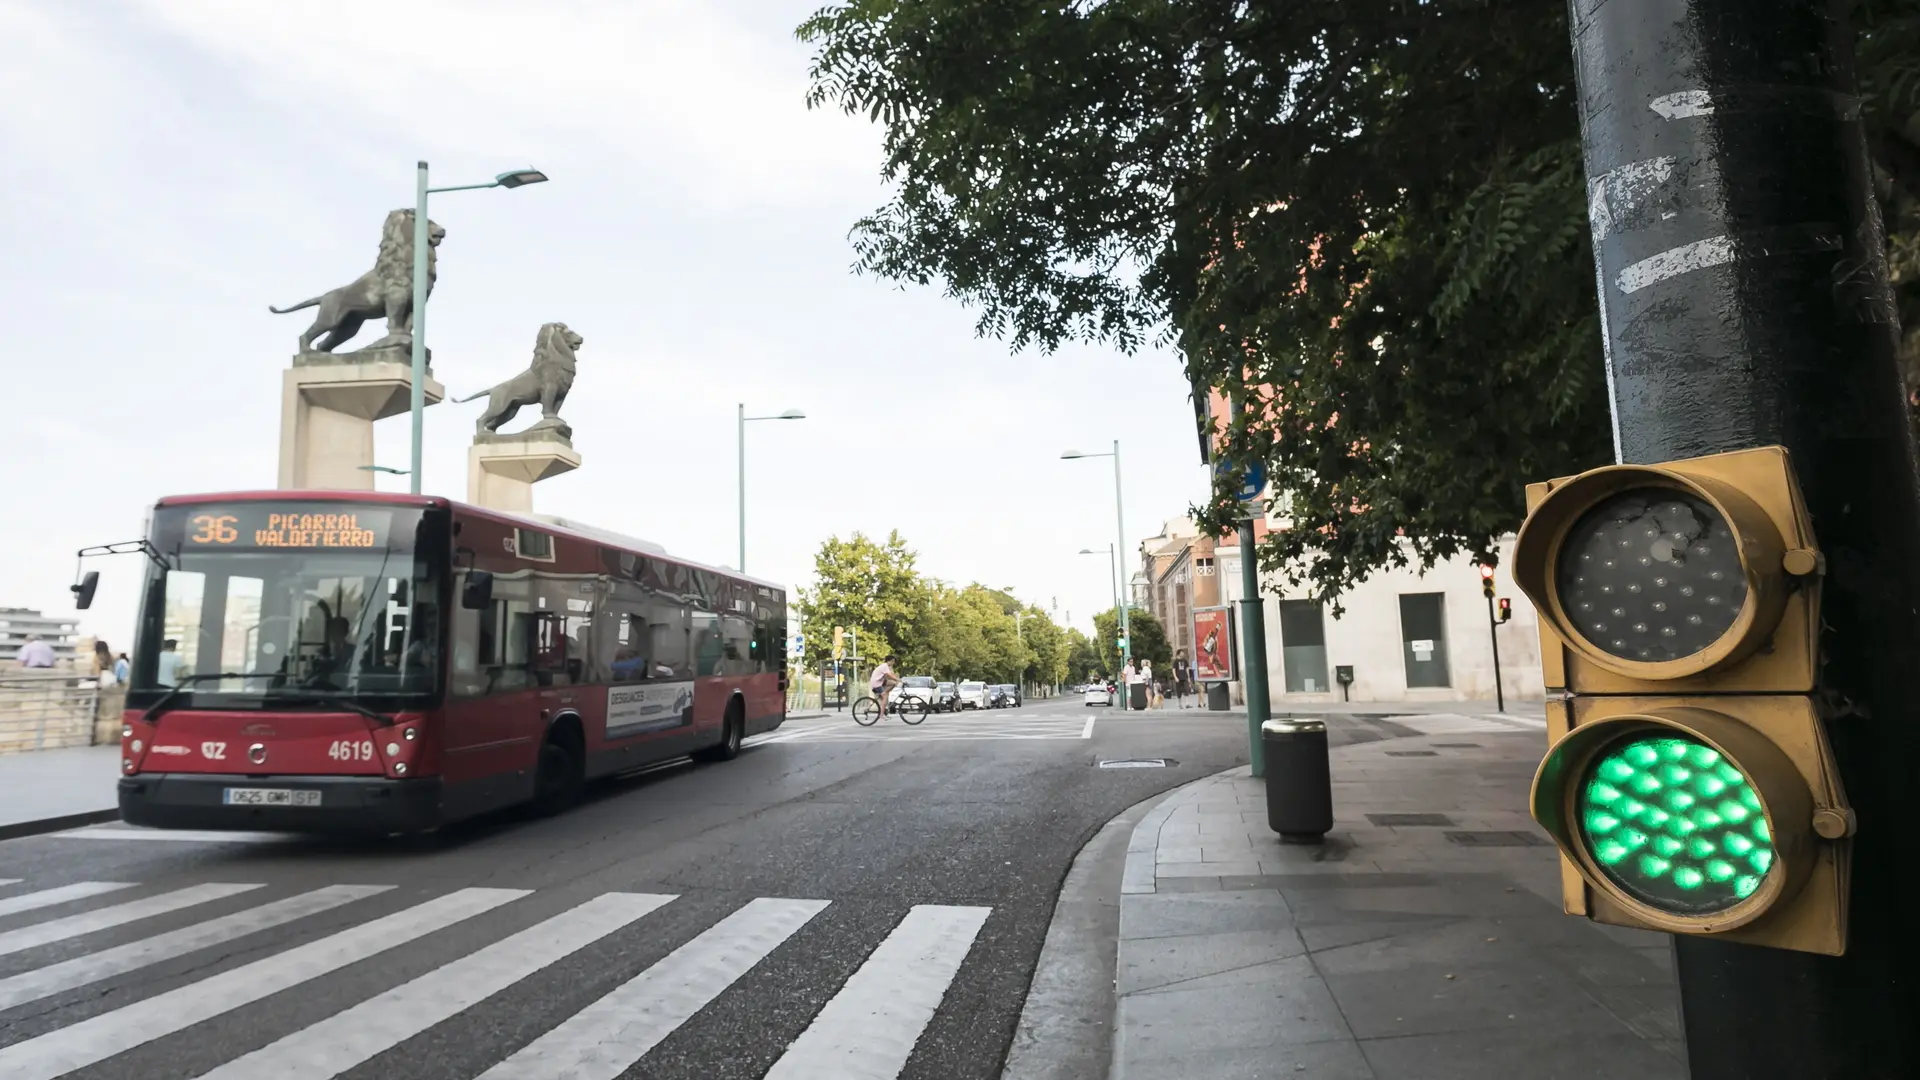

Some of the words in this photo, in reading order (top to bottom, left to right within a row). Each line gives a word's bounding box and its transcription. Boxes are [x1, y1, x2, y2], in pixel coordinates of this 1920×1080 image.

[192, 515, 238, 544] 36
[268, 513, 361, 530] PICARRAL
[255, 530, 375, 547] VALDEFIERRO
[328, 740, 373, 761] 4619
